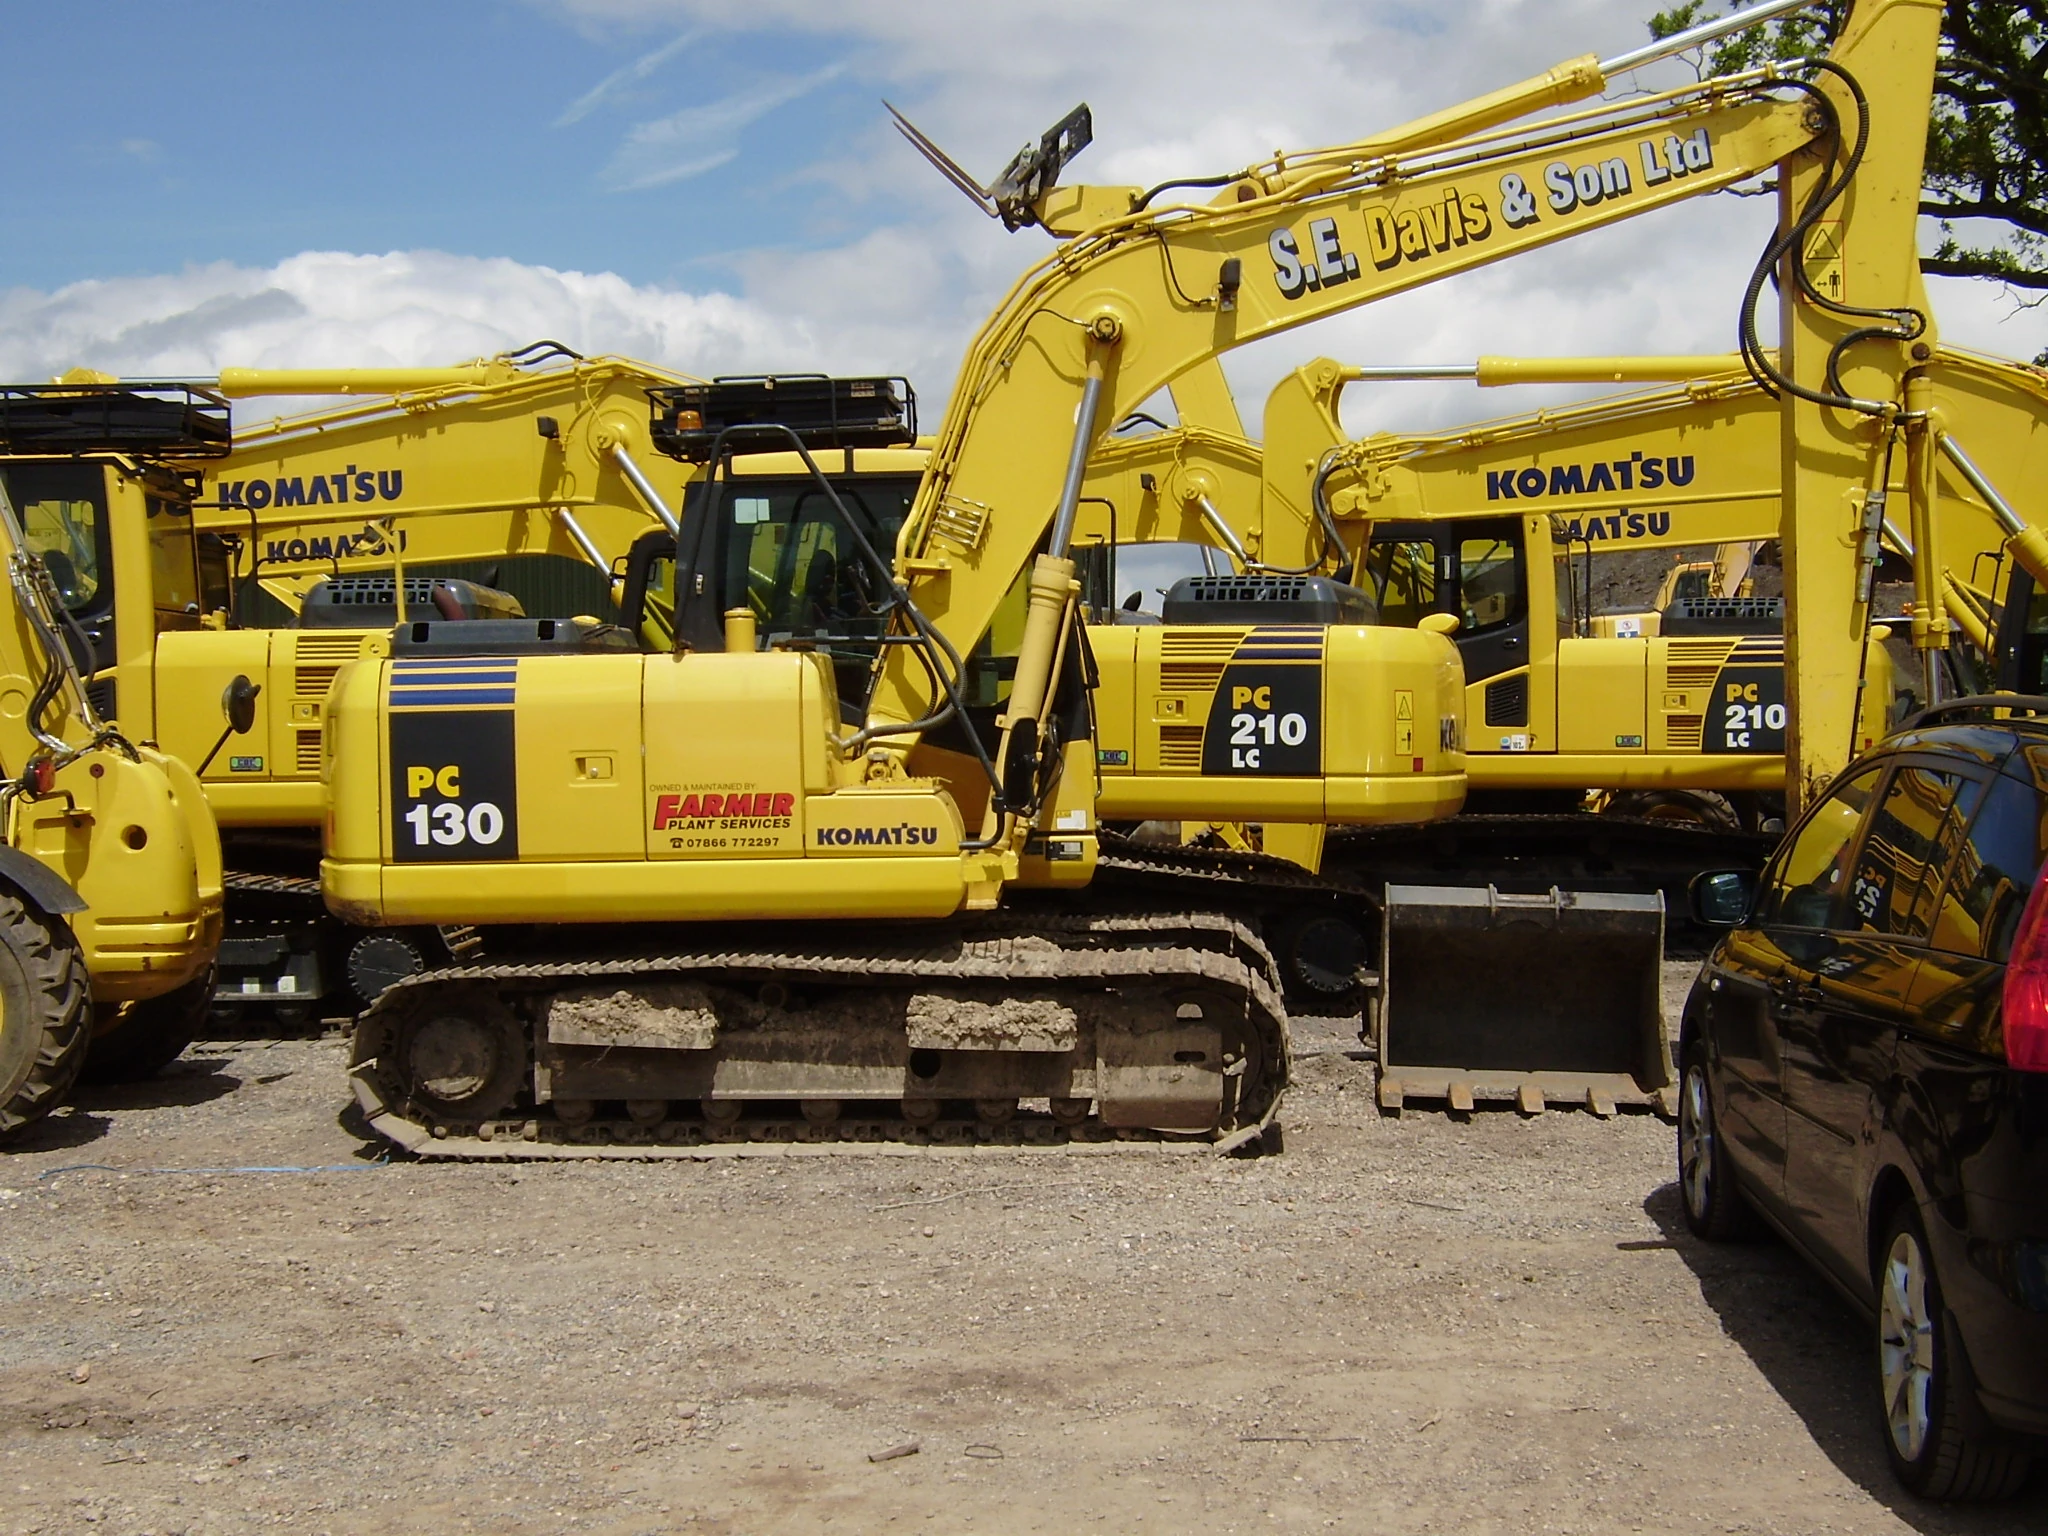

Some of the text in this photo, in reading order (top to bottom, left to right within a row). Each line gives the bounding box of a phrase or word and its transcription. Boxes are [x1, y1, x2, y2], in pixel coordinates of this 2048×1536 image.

[1268, 128, 1714, 299] S.E. Davis & Son Ltd
[218, 464, 402, 511] KOMATSU
[1487, 451, 1694, 500] KOMATSU
[1557, 508, 1670, 542] MATSU
[1232, 686, 1271, 710] PC
[1726, 683, 1758, 702] PC
[1230, 712, 1307, 745] 210
[1725, 703, 1786, 730] 210
[1726, 732, 1750, 747] LC
[1232, 748, 1260, 769] LC
[407, 765, 459, 797] PC
[649, 784, 681, 792] OWNED
[691, 783, 742, 791] MAINTAINED
[405, 802, 502, 846] 130
[653, 793, 795, 830] FARMER
[668, 818, 791, 830] PLANT SERVICES
[687, 837, 780, 848] 07866 772297
[817, 822, 938, 847] KOMATSU
